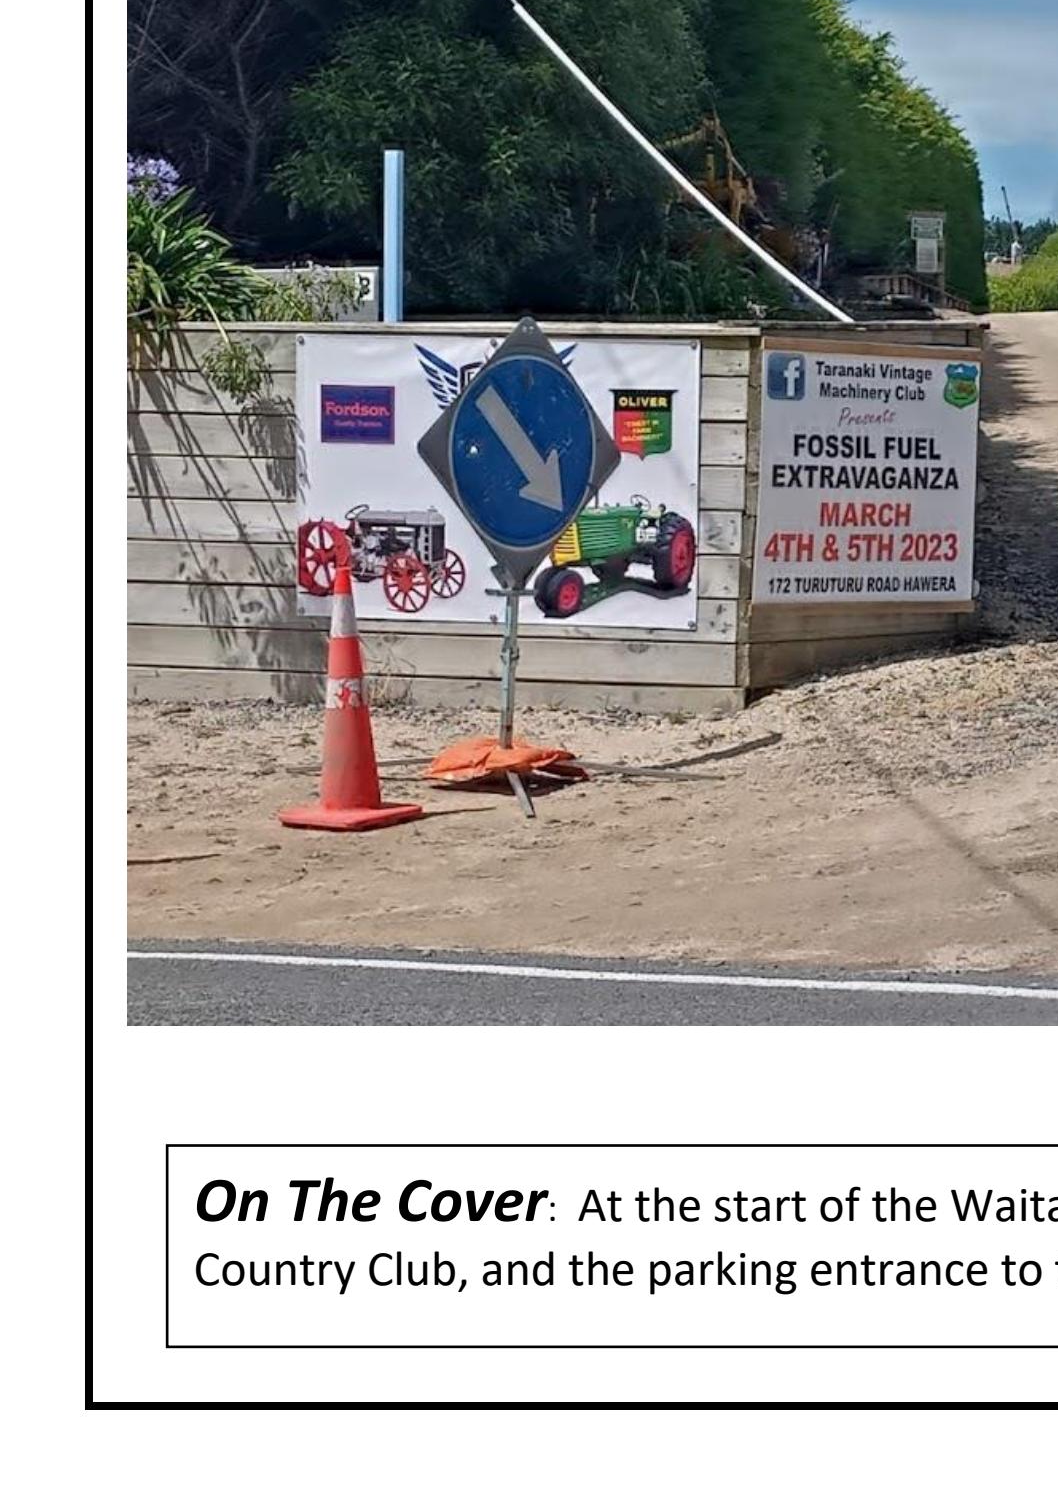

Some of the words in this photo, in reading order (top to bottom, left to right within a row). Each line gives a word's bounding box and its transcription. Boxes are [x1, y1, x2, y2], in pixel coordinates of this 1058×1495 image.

[815, 360, 876, 380] Taranaki
[879, 363, 933, 384] Vintage
[618, 395, 669, 408] OLIVER
[819, 382, 892, 403] Machinery
[895, 385, 926, 401] Club
[324, 400, 391, 417] Fordson
[838, 406, 897, 427] Presents
[792, 433, 877, 460] FOSSIL
[883, 435, 942, 461] FUEL
[771, 463, 960, 491] EXTRAVAGANZA
[819, 501, 912, 528] MARCH
[763, 532, 815, 563] 4TH
[821, 532, 839, 563] &
[846, 532, 895, 563] 5TH
[900, 532, 959, 563] 2023
[768, 576, 791, 594] 172
[794, 576, 864, 594] TURUTURU
[866, 576, 901, 594] ROAD
[903, 575, 957, 593] HAWERA
[196, 1179, 269, 1223] On
[289, 1176, 381, 1223] The
[578, 1189, 622, 1223] At
[634, 1186, 701, 1223] the
[714, 1190, 807, 1223] start
[819, 1186, 861, 1223] of
[871, 1187, 937, 1223] the
[195, 1252, 356, 1295] Country
[368, 1250, 467, 1293] Club,
[482, 1250, 554, 1287] and
[568, 1250, 634, 1287] the
[649, 1250, 797, 1295] parking
[810, 1254, 988, 1287] entrance
[1000, 1254, 1043, 1287] to
